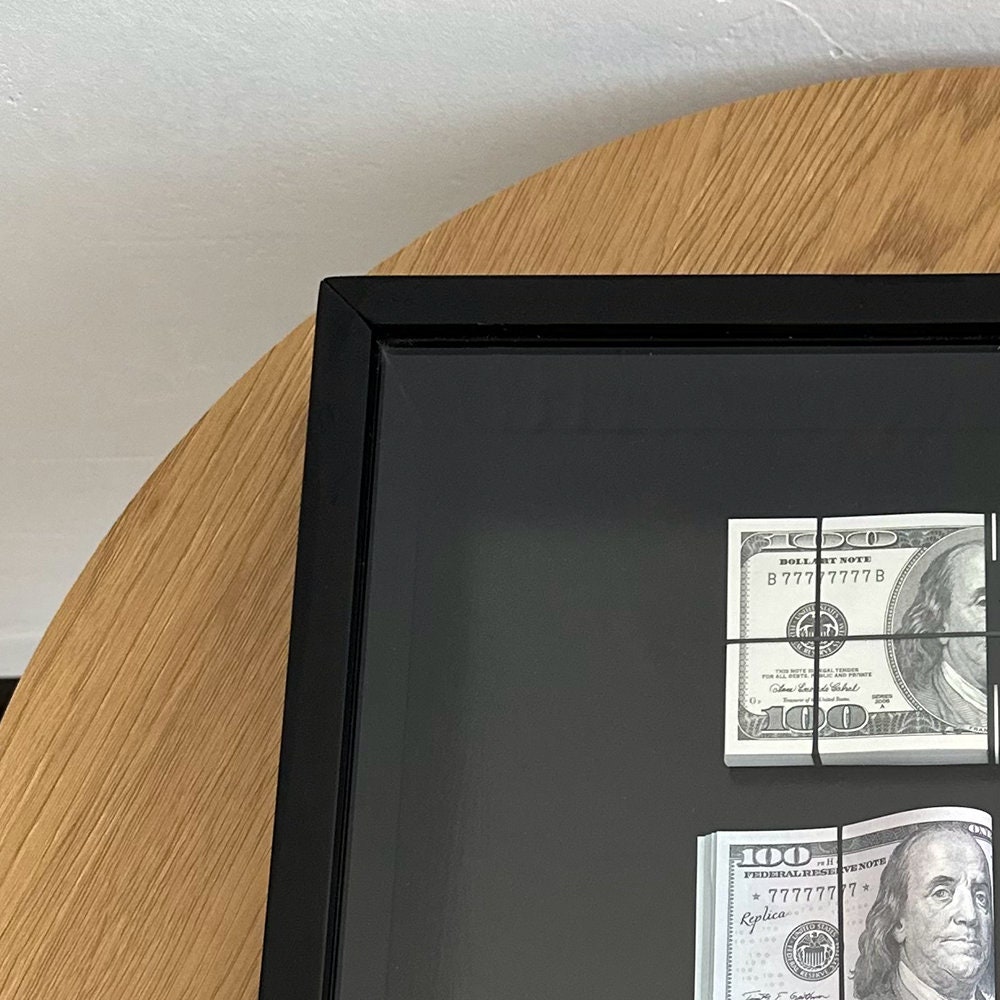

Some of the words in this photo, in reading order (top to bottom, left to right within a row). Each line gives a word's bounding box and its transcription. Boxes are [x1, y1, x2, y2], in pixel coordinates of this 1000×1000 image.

[840, 555, 872, 564] NOTE
[761, 704, 867, 731] 100
[737, 847, 812, 867] 100
[744, 870, 800, 879] FEDERAL
[802, 865, 857, 877] RESEVE
[858, 857, 887, 870] NOTE
[740, 906, 786, 934] Replica
